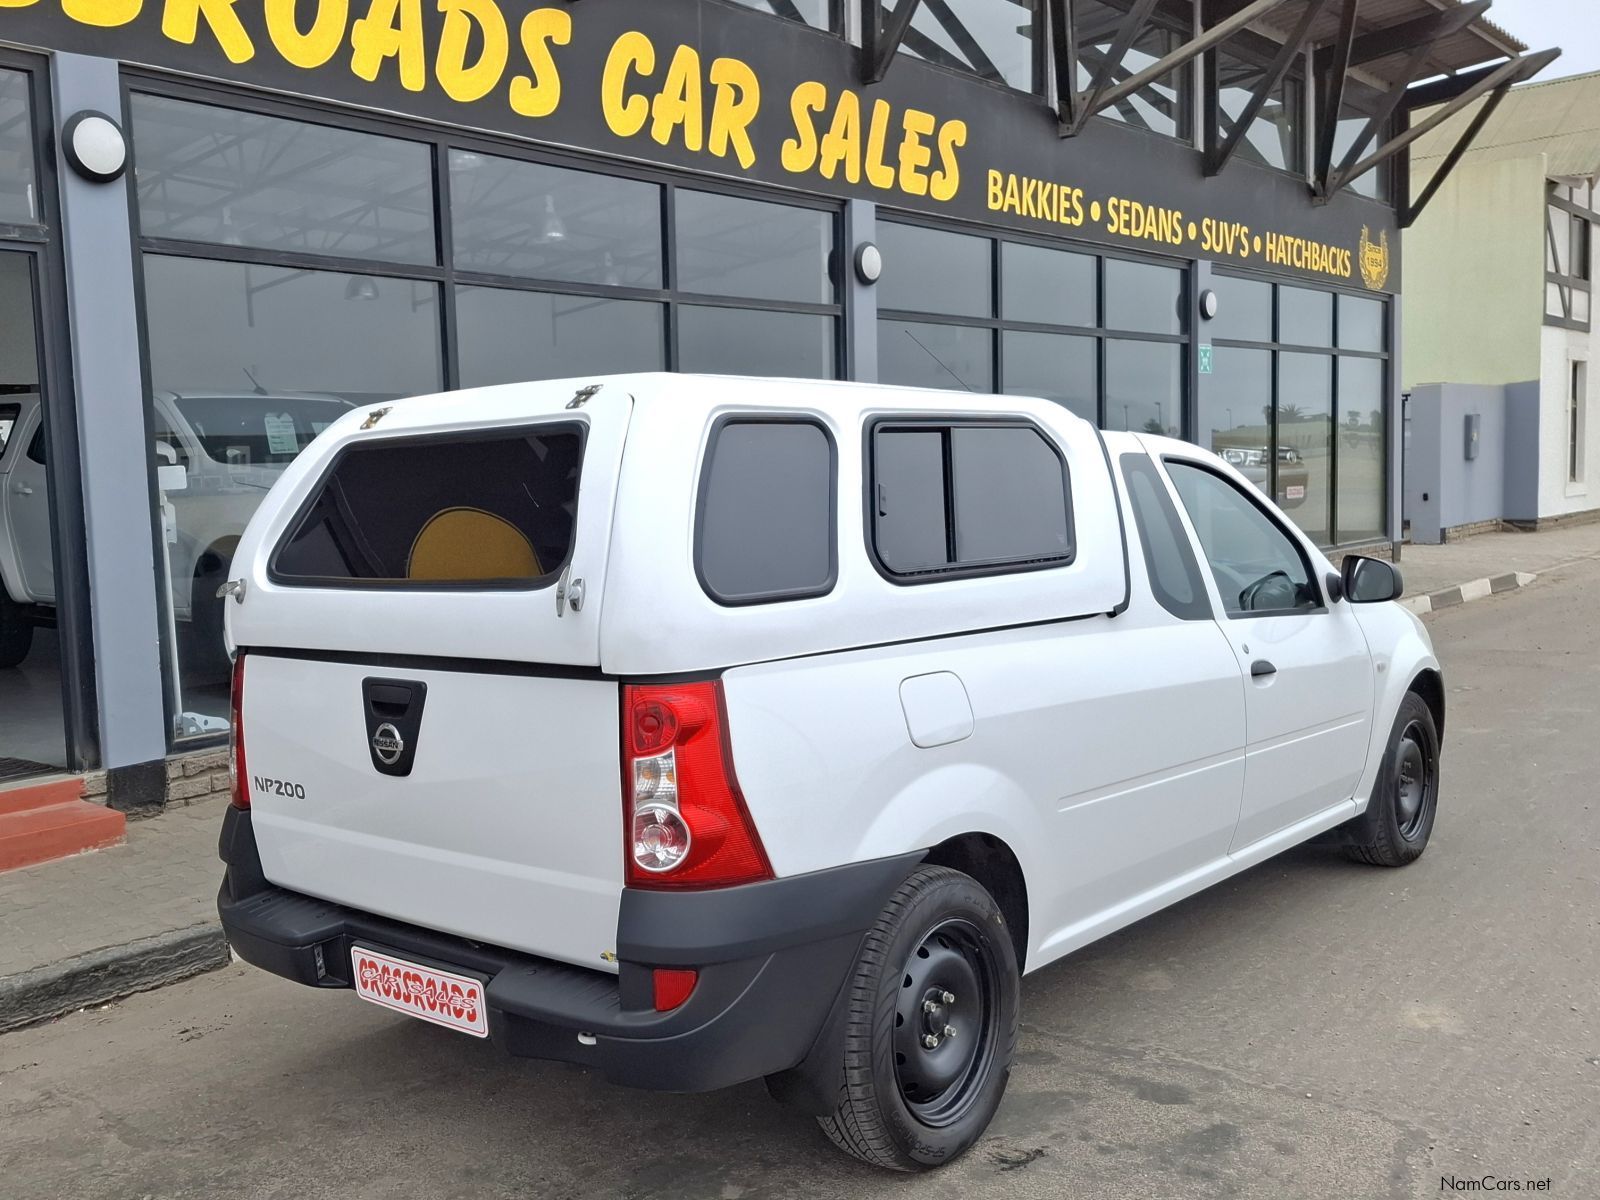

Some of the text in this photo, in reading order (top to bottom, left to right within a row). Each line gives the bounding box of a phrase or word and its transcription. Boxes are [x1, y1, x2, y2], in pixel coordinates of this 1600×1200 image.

[601, 30, 761, 170] CAR
[780, 80, 968, 202] SALES
[987, 168, 1352, 279] BAKKIES SEDANS SUV'S HATCHBACKS
[253, 775, 306, 800] NP200
[358, 957, 478, 1023] CROSSROADS
[360, 968, 476, 1009] CAR SALES
